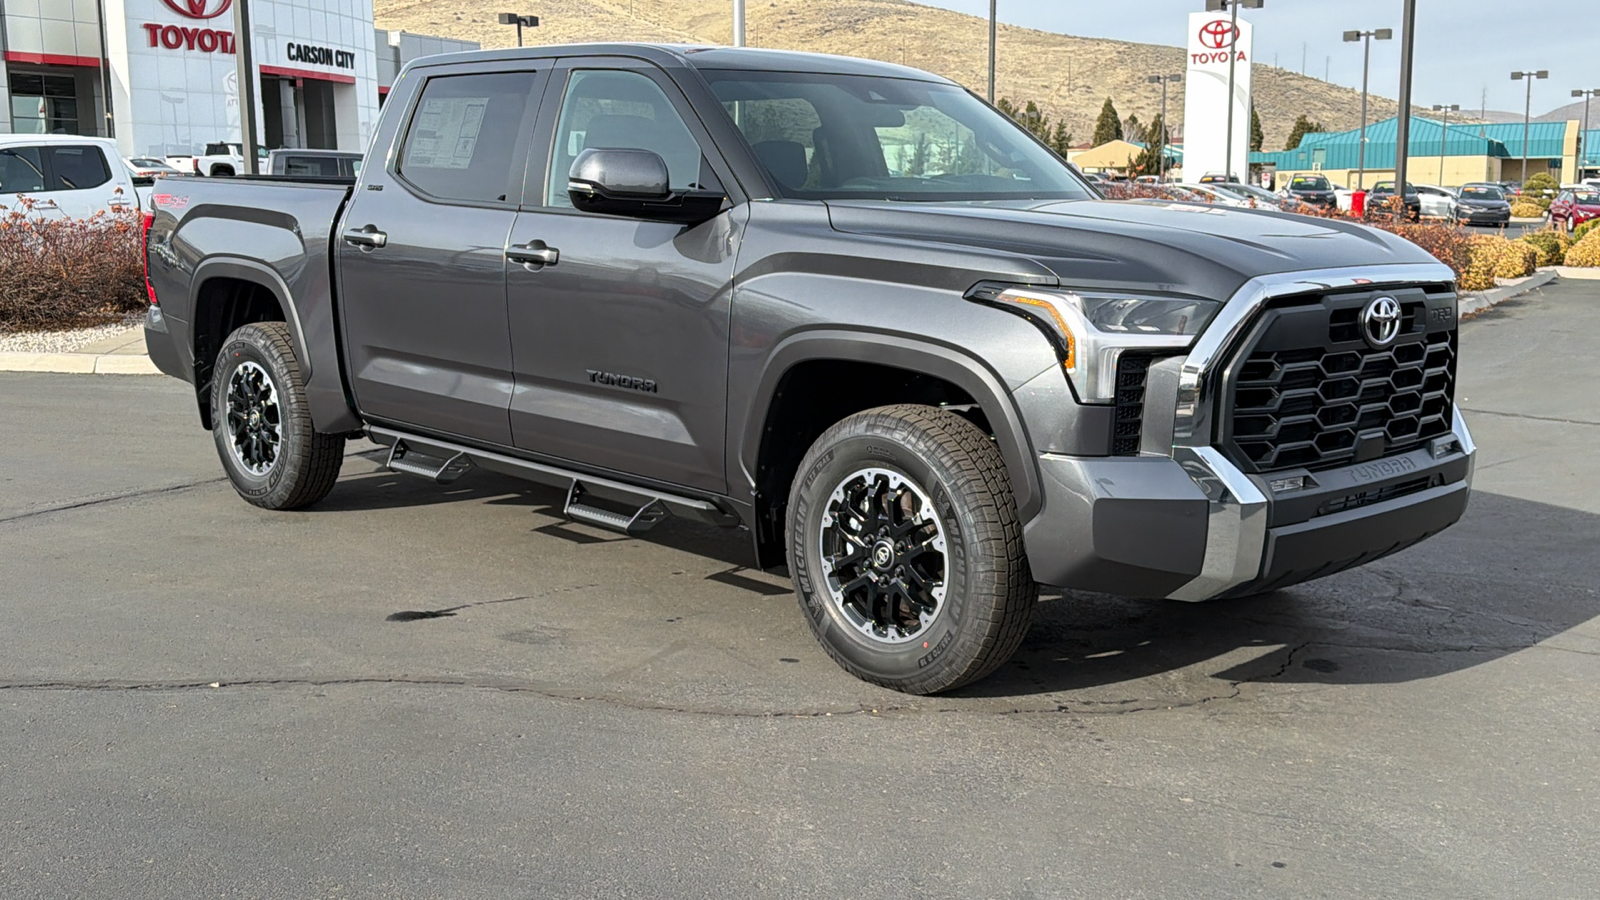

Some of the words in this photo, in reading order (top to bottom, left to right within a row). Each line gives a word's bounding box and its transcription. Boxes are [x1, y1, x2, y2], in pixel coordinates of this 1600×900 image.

[287, 42, 333, 66] CARSON
[335, 50, 355, 69] CITY
[585, 369, 658, 393] TUNDRA
[1342, 456, 1417, 482] TUNDRA
[795, 500, 812, 593] MICHELIN
[946, 518, 965, 621] MICHELIN
